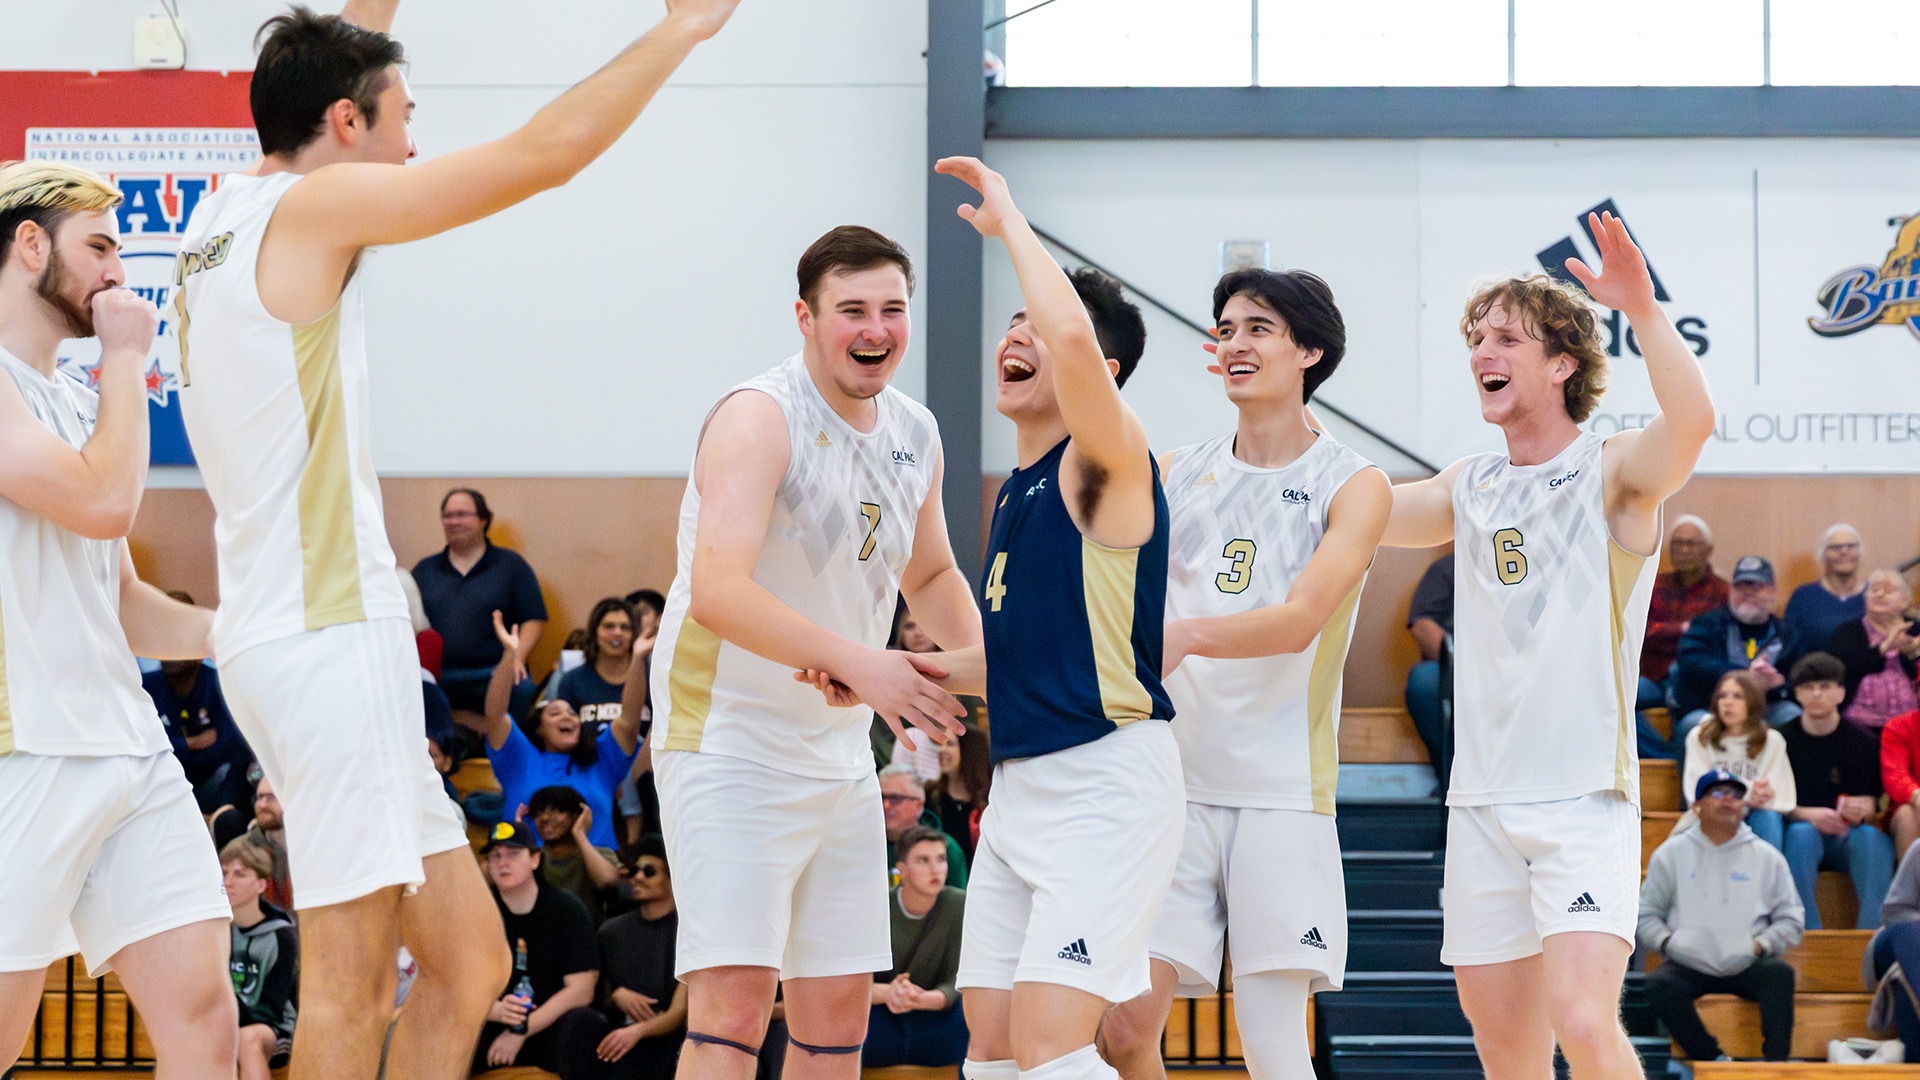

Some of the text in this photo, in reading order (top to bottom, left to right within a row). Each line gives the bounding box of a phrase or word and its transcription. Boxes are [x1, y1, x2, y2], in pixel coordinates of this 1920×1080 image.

[32, 133, 256, 143] NATIONAL ASSOCIATION
[31, 151, 257, 162] INTERCOLLEGIATE ATHLET
[858, 501, 881, 561] 7
[1493, 528, 1528, 586] 6
[1215, 538, 1257, 594] 3
[985, 552, 1008, 612] 4
[1567, 903, 1601, 913] adidas
[1300, 938, 1328, 950] adidas
[1057, 951, 1092, 966] adidas
